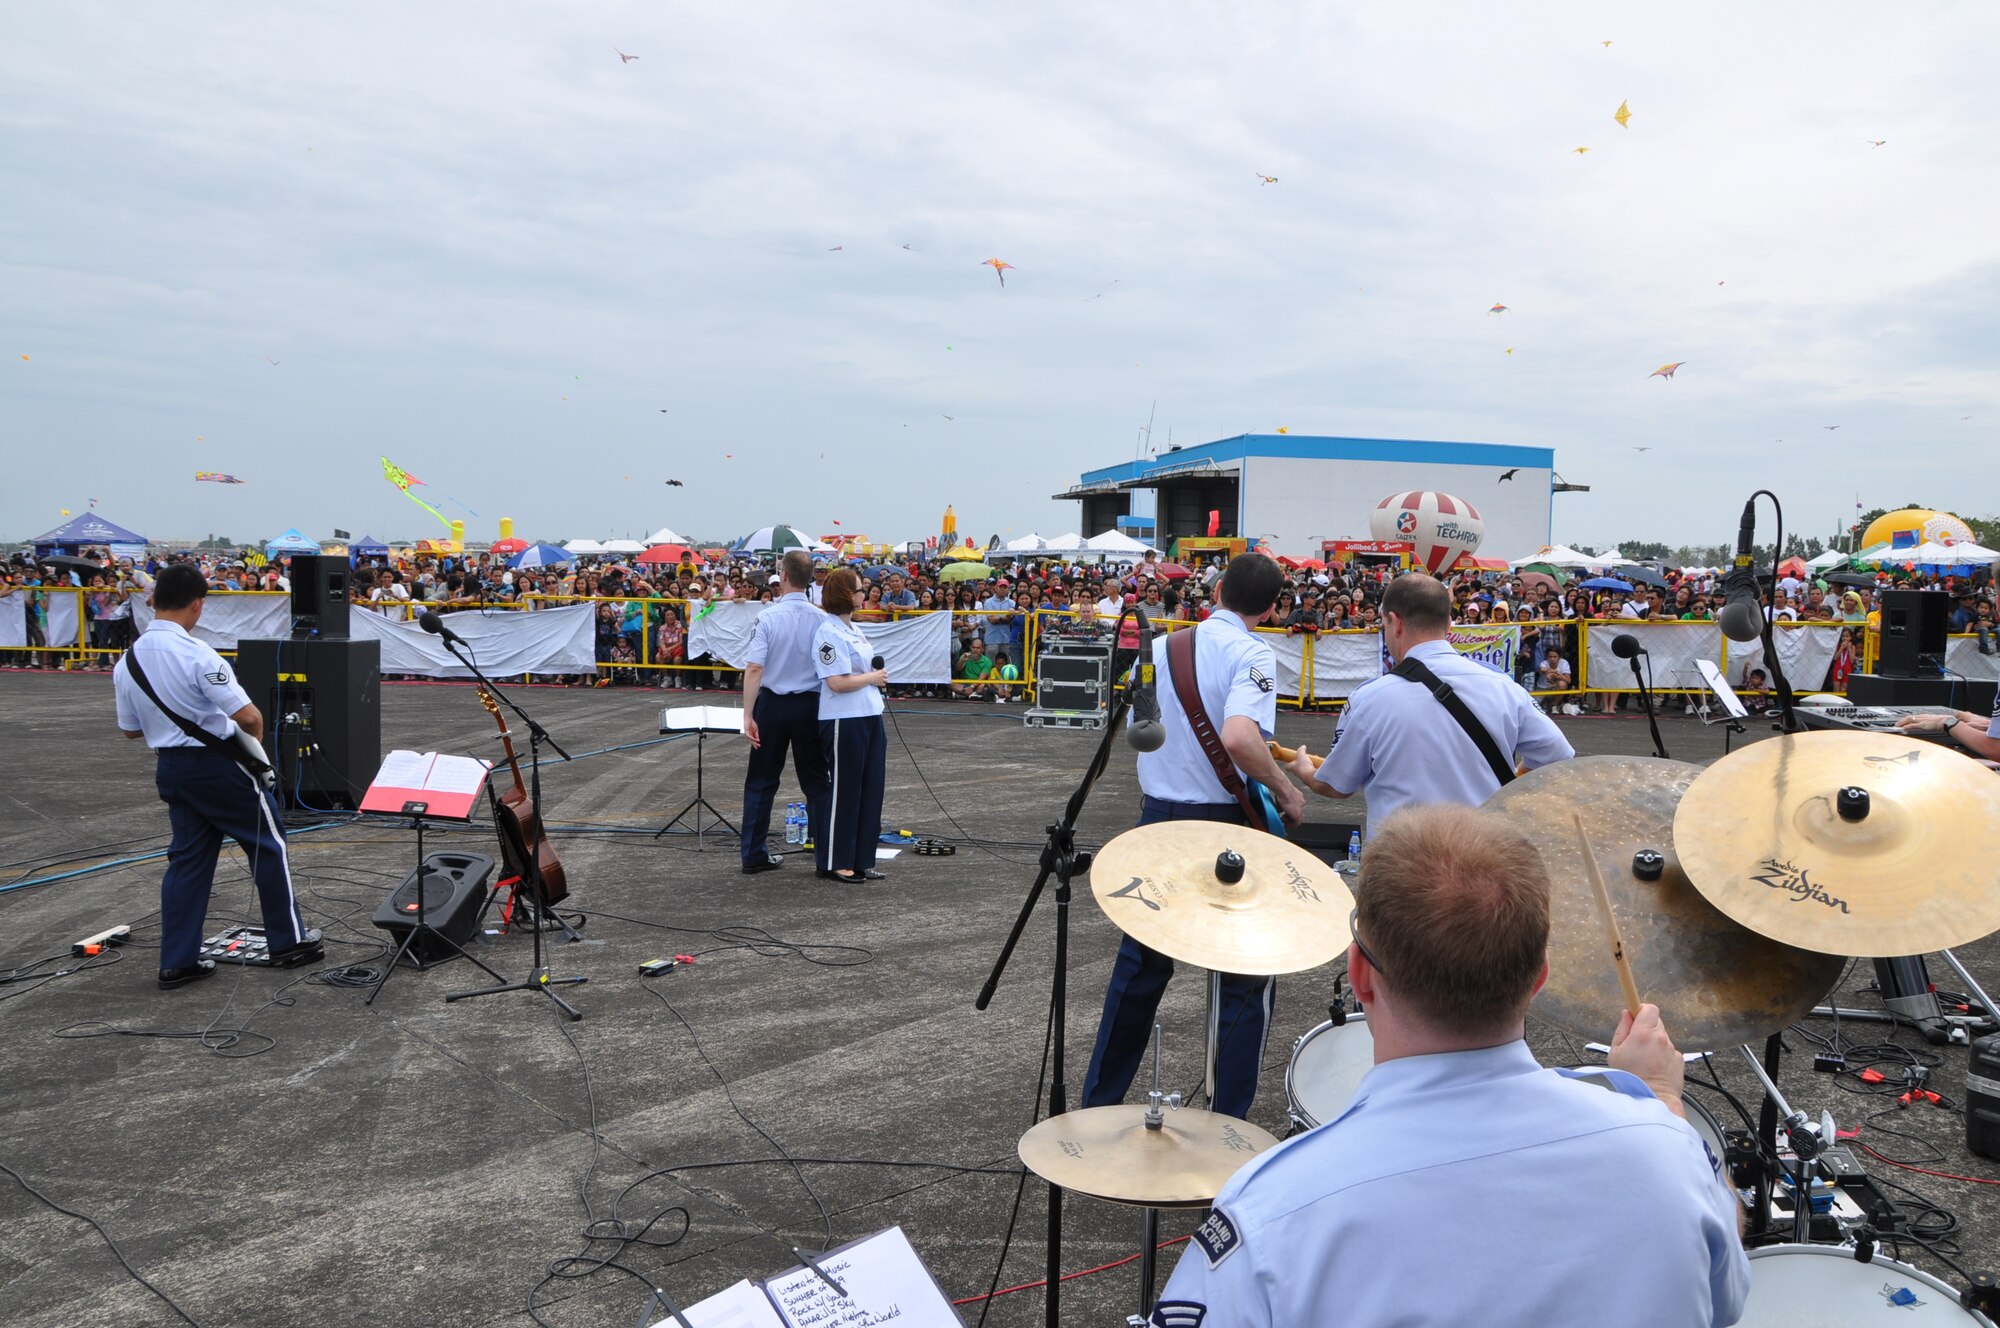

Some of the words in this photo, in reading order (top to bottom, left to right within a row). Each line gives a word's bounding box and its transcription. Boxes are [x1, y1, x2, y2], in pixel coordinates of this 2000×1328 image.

[1442, 522, 1459, 530] with
[1436, 525, 1480, 544] TECHRON
[1345, 543, 1372, 551] Jollibee
[1446, 632, 1502, 645] Welcome
[1760, 859, 1800, 873] Avedis
[1748, 869, 1850, 914] Zildjian
[1207, 1214, 1231, 1243] BAND
[1197, 1223, 1224, 1254] ACIFIC
